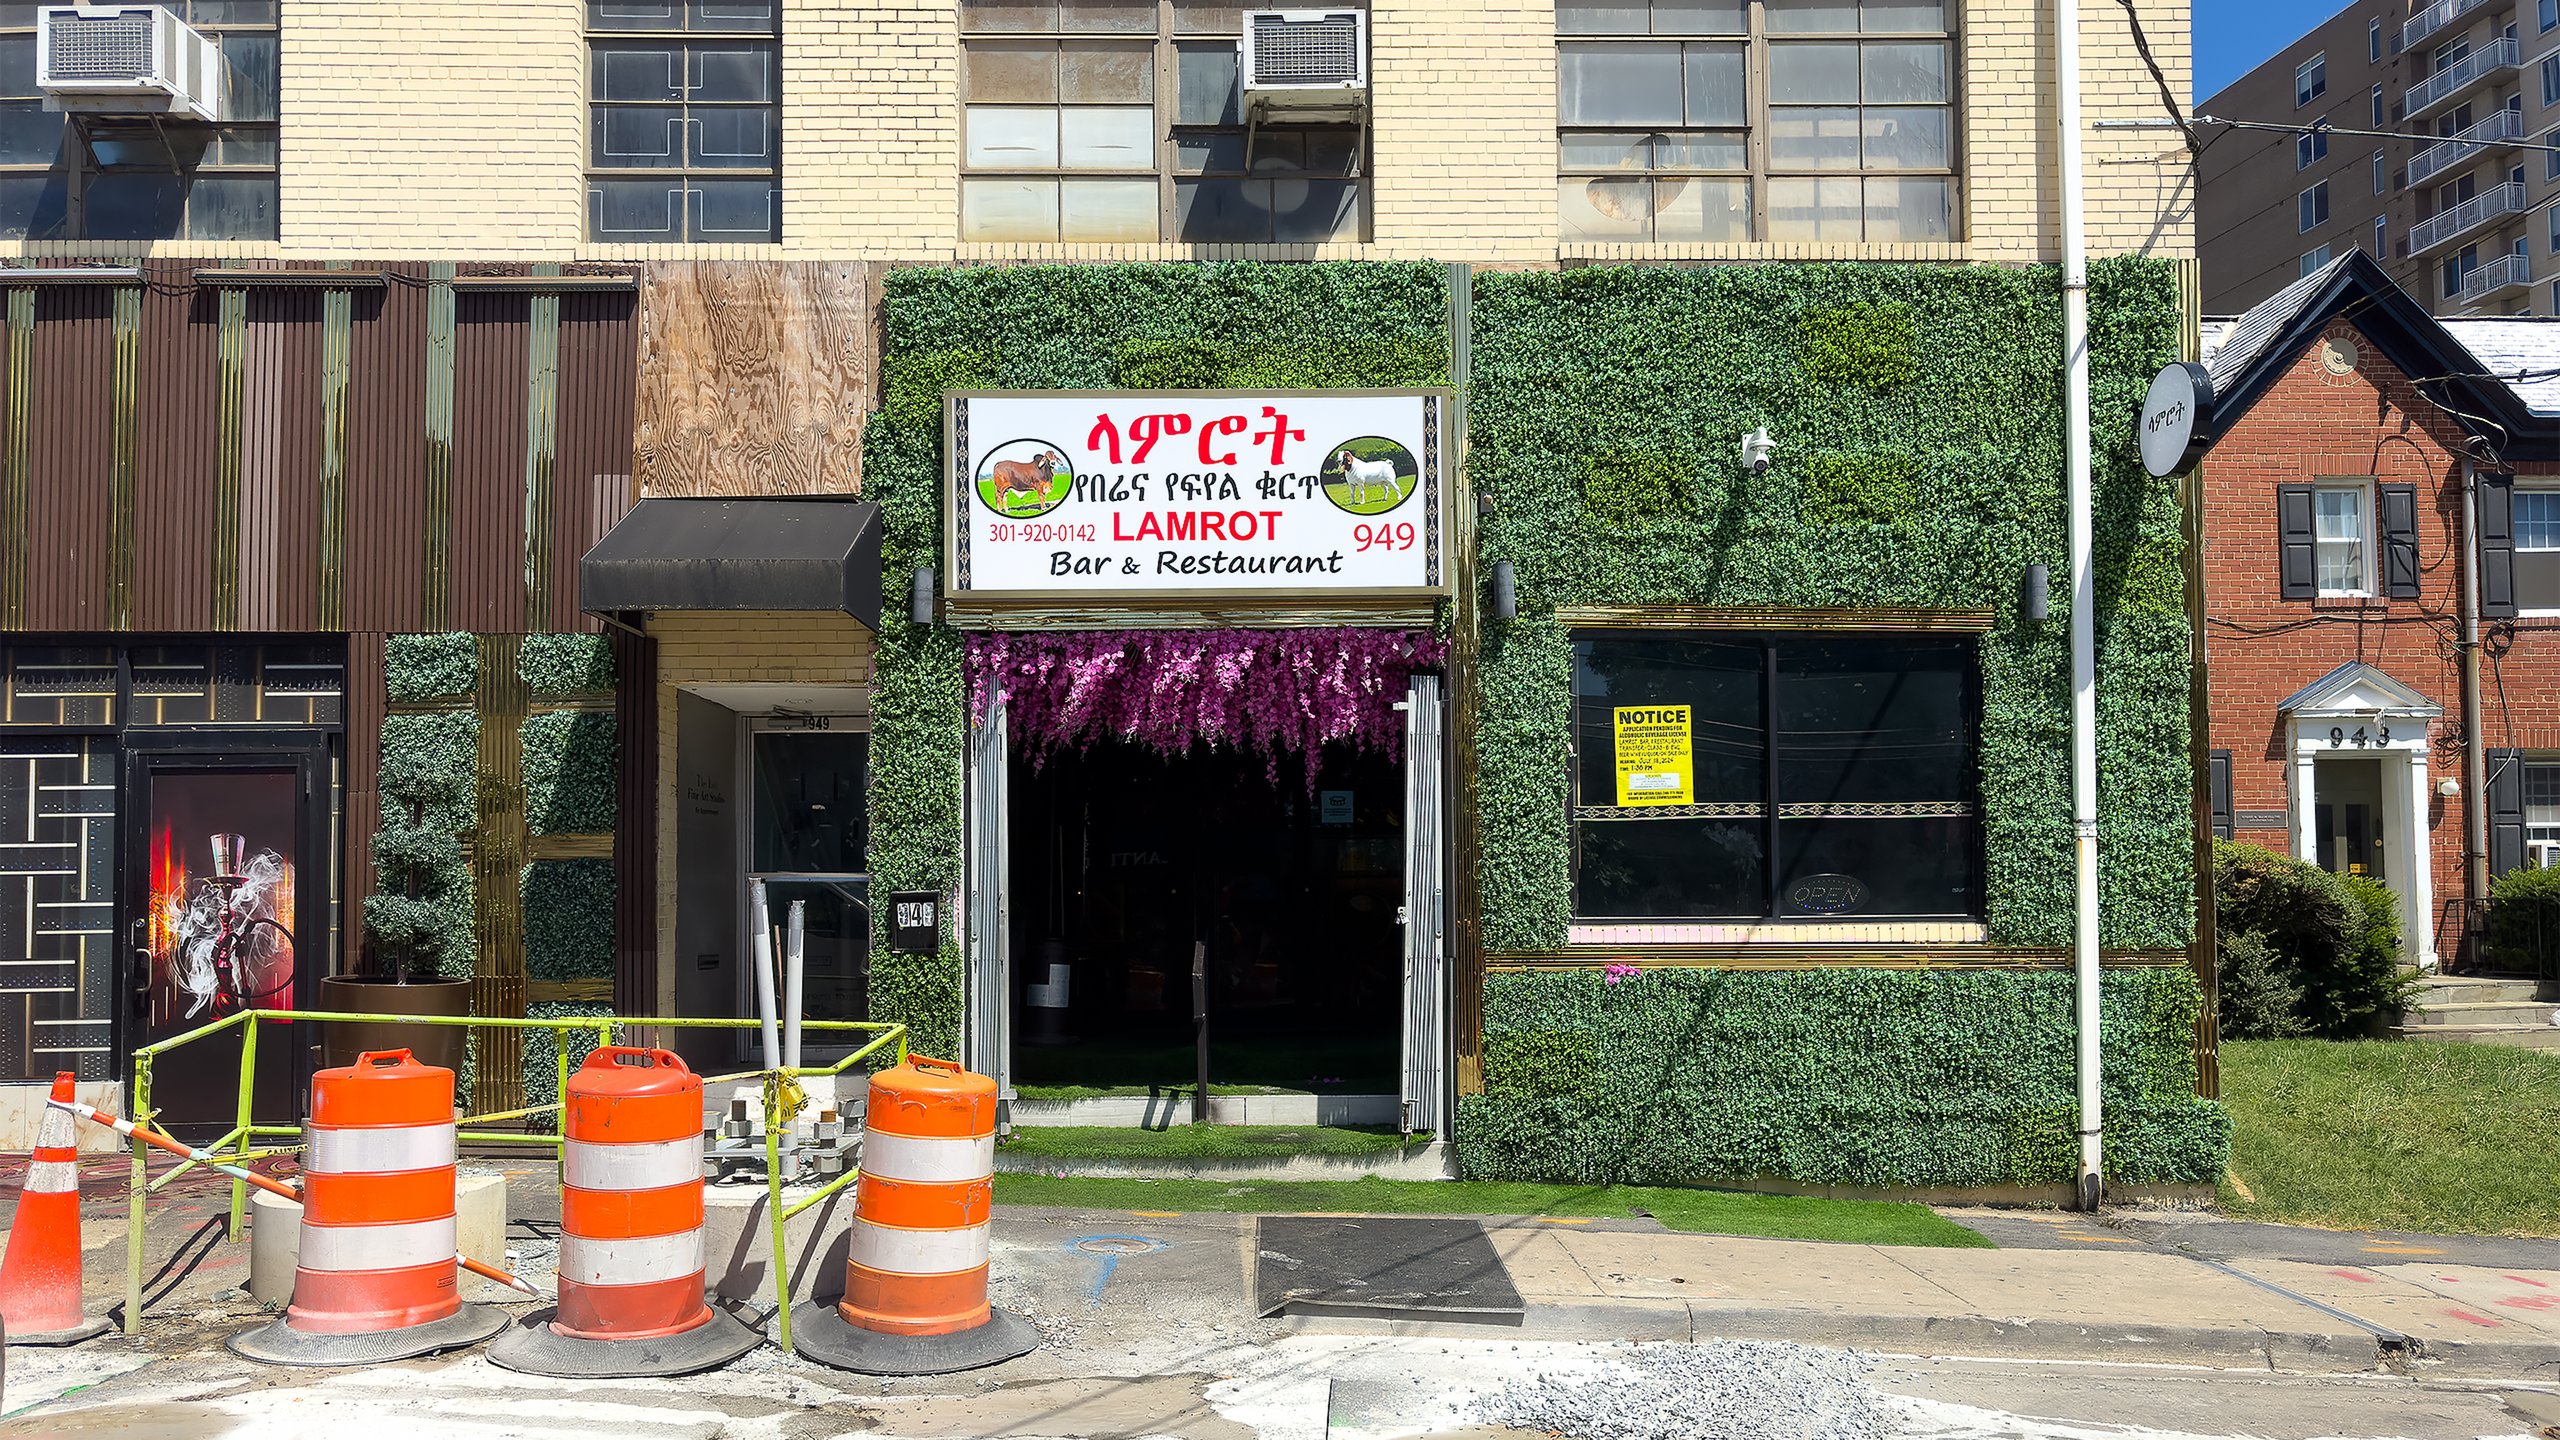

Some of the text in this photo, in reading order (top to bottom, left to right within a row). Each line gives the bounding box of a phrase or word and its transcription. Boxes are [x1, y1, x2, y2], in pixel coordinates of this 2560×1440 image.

[1088, 406, 1305, 465] ላምሮት
[989, 523, 1096, 542] 301-920-0142
[1113, 511, 1283, 542] LAMROT
[1354, 523, 1415, 552] 949
[1050, 549, 1344, 576] Bar & Restaurant
[808, 716, 830, 731] 949
[1619, 710, 1687, 724] NOTICE
[2330, 726, 2390, 749] 943
[1794, 886, 1861, 903] OPEN
